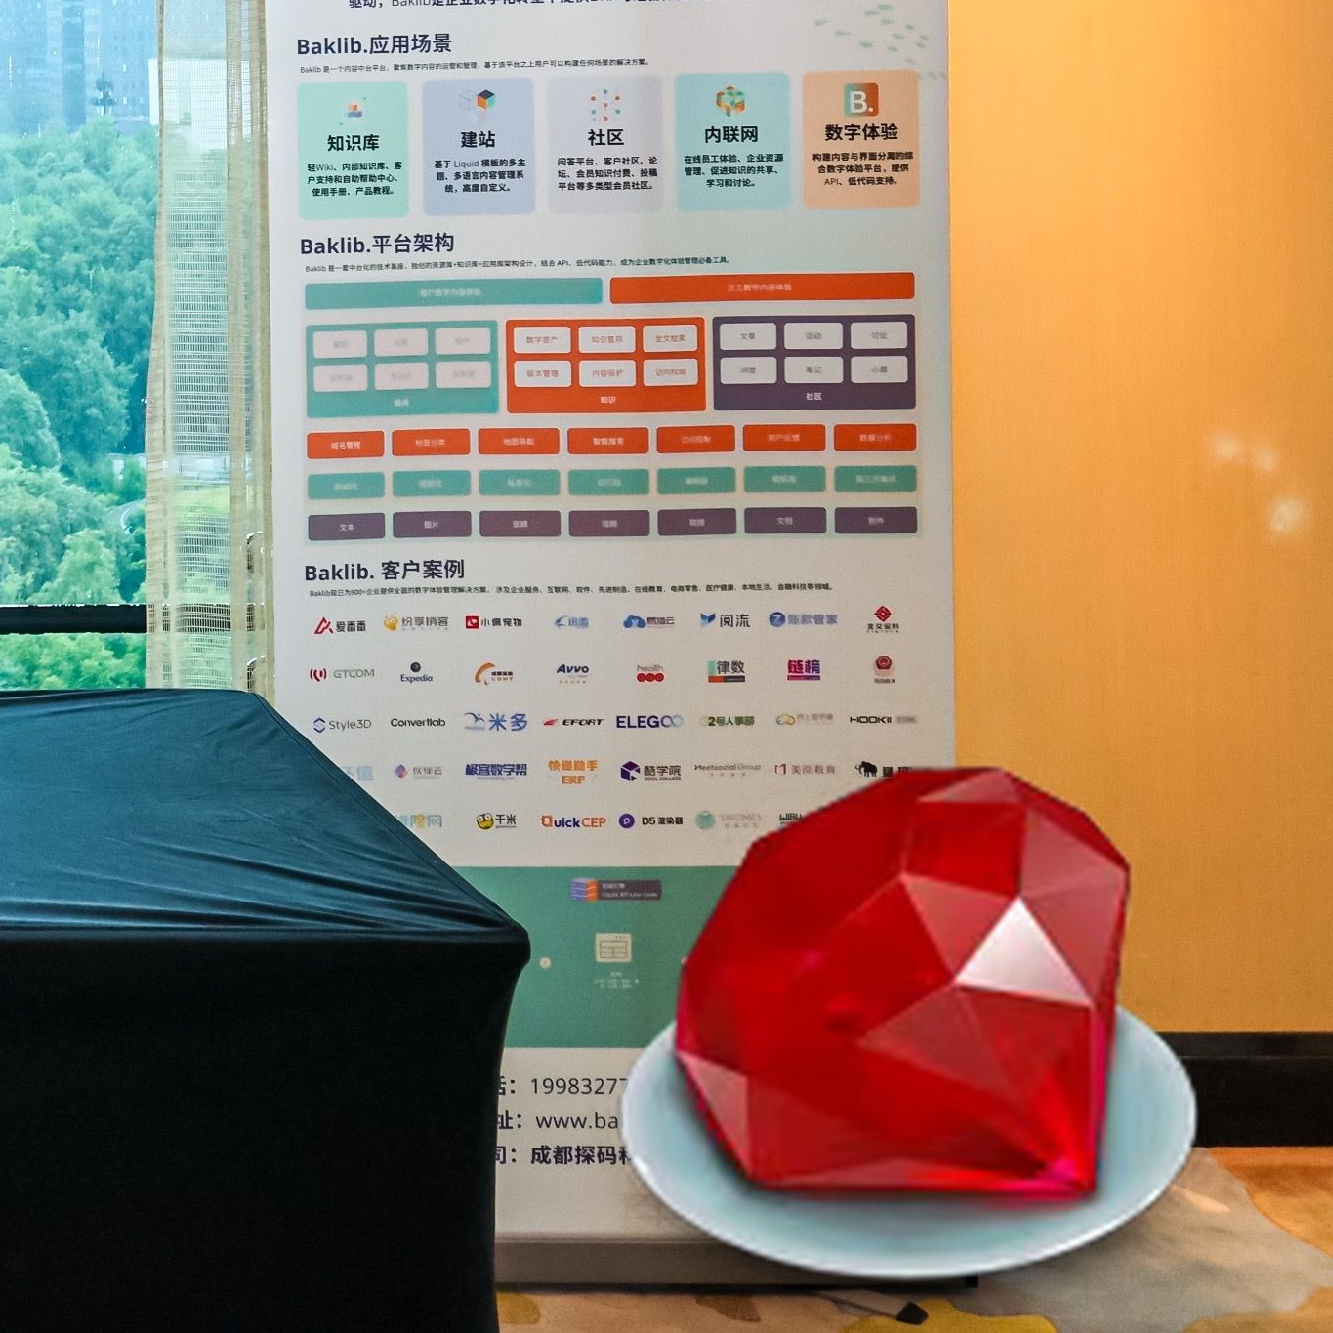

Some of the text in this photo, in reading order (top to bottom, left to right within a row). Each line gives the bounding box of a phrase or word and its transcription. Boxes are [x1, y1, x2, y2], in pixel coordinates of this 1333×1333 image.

[296, 33, 453, 56] Baklib.应用场景
[460, 130, 496, 149] 建站
[587, 128, 625, 147] 社区
[704, 125, 759, 144] 内联网
[824, 123, 898, 141] 数字体验
[327, 133, 381, 152] 知识库
[300, 232, 455, 255] Baklib.平台架构
[304, 558, 466, 582] Baklib. 客户案例
[399, 673, 434, 684] Expedia
[328, 719, 372, 732] Style3D
[488, 712, 528, 732] 米多
